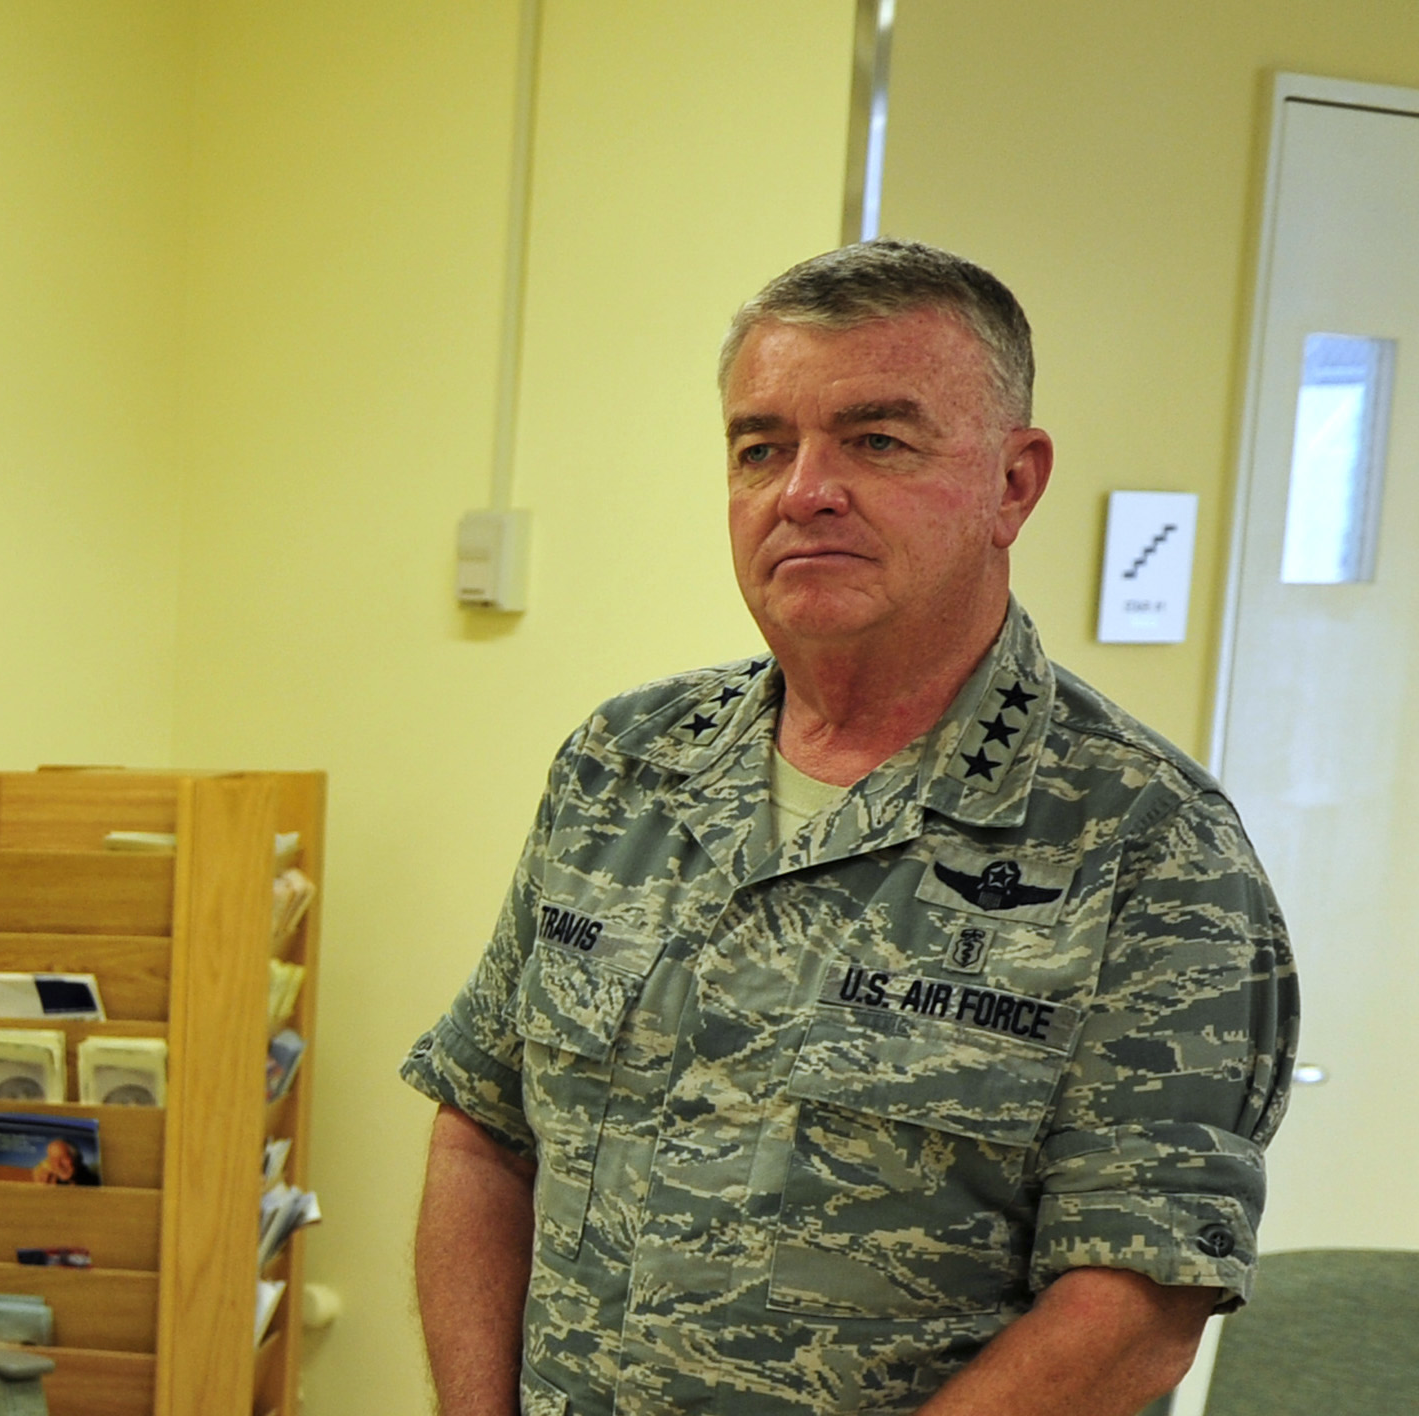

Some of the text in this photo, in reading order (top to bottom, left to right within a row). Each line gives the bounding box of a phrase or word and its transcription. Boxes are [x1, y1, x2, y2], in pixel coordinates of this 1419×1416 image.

[539, 906, 604, 952] TRAVIS
[840, 968, 1056, 1041] U.S. AIR FORCE
